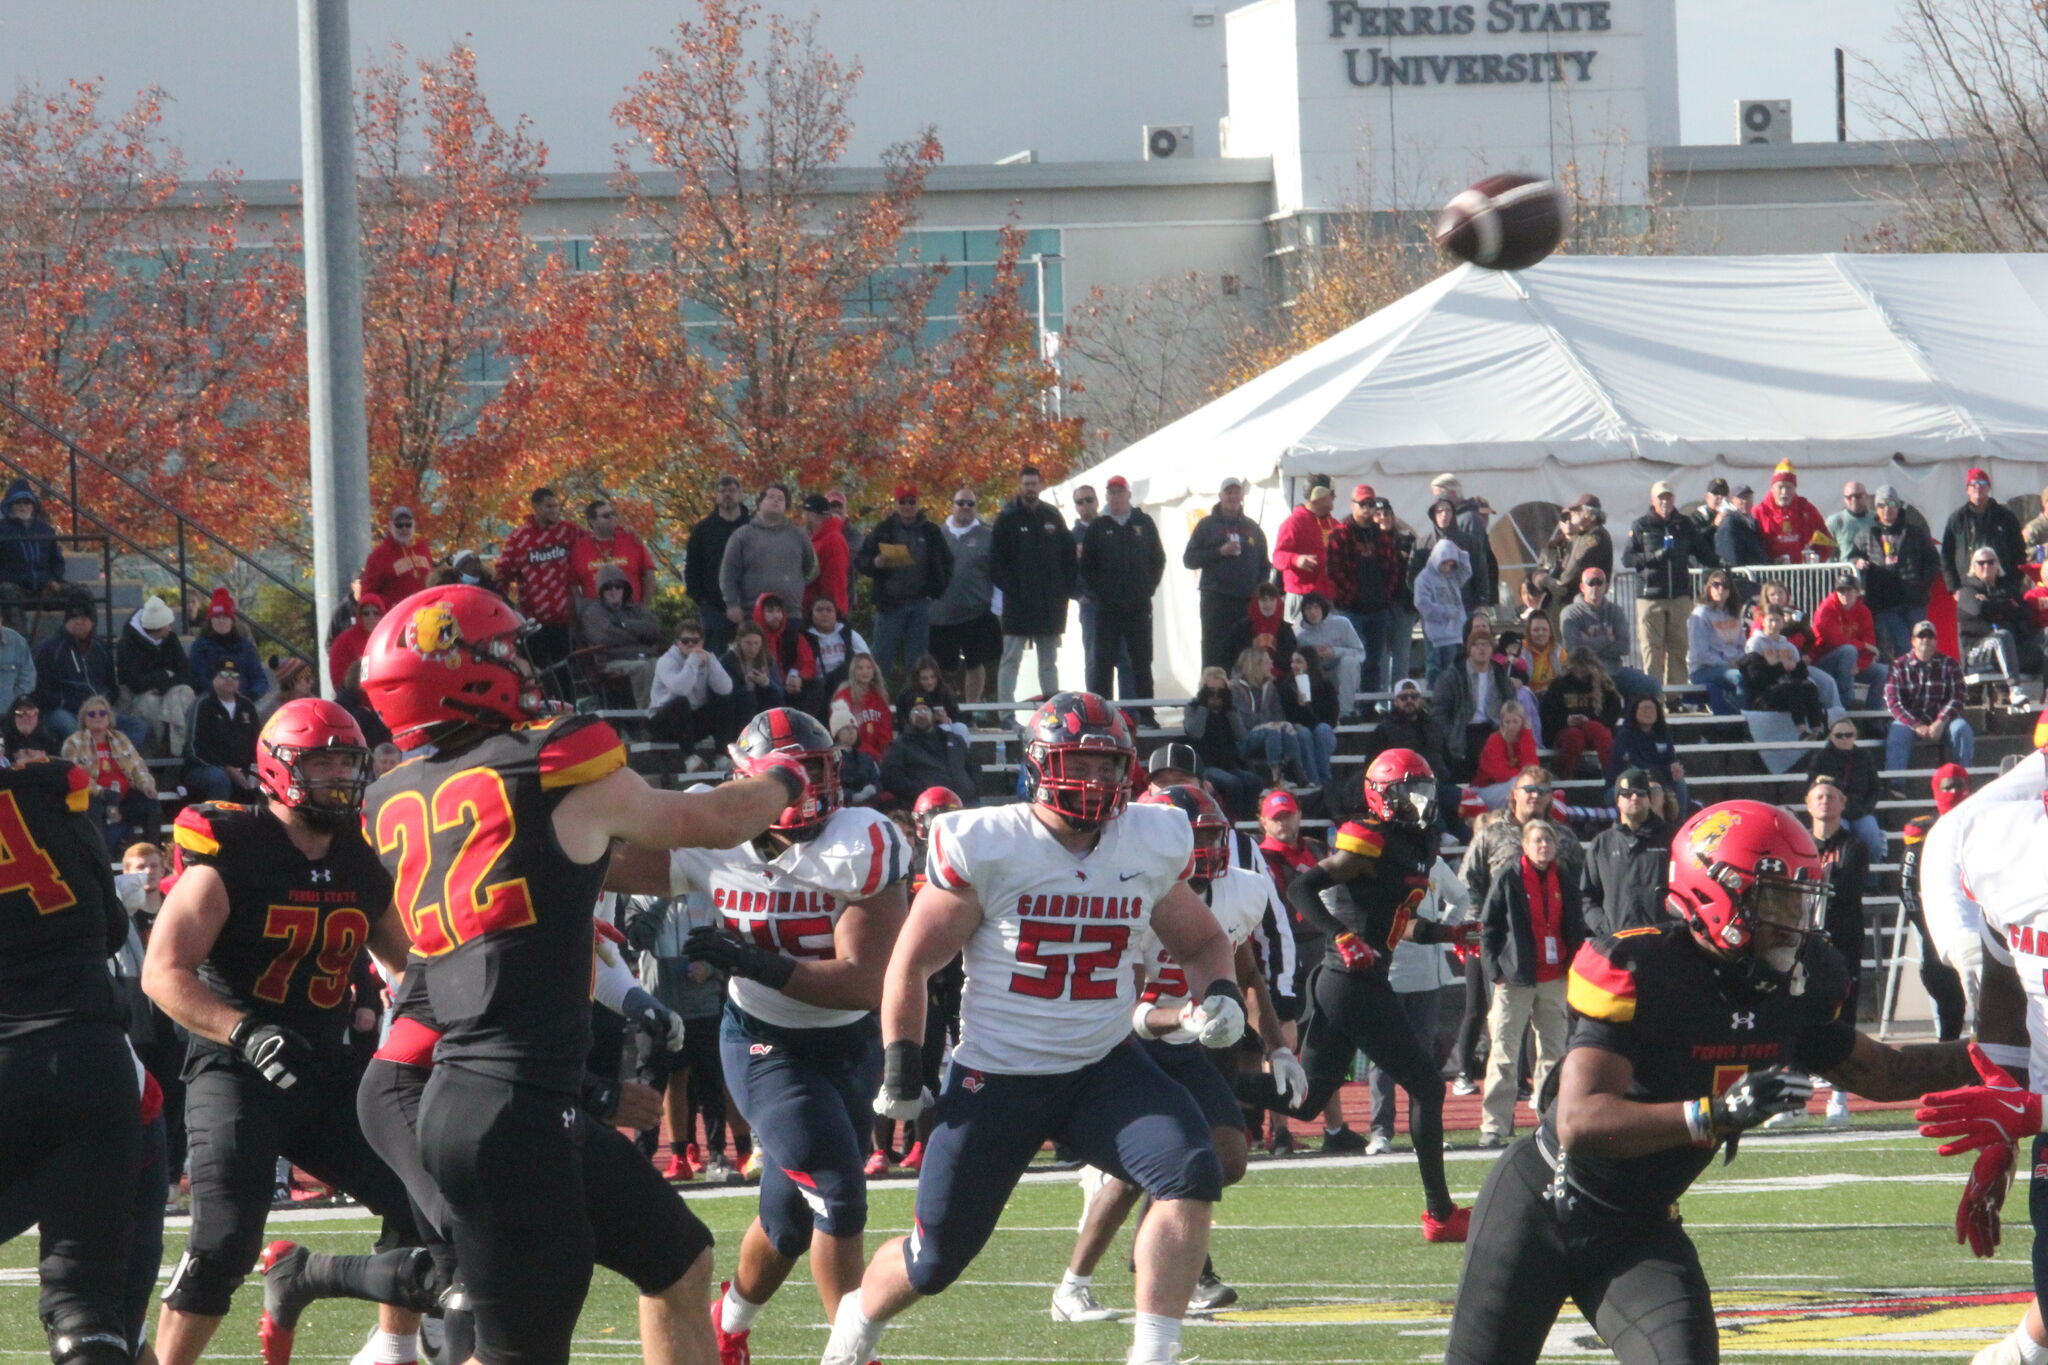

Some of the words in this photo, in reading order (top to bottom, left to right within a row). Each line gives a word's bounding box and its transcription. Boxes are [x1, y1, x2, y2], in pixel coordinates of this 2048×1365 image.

[1328, 1, 1475, 38] FERRIS
[1486, 0, 1612, 34] STATE
[1343, 48, 1598, 87] UNIVERSITY
[529, 546, 566, 563] Hustle
[375, 766, 538, 958] 22
[713, 888, 836, 913] CARDINALS
[1016, 894, 1143, 919] CARDINALS
[252, 904, 370, 1009] 79
[1008, 918, 1131, 1001] 52
